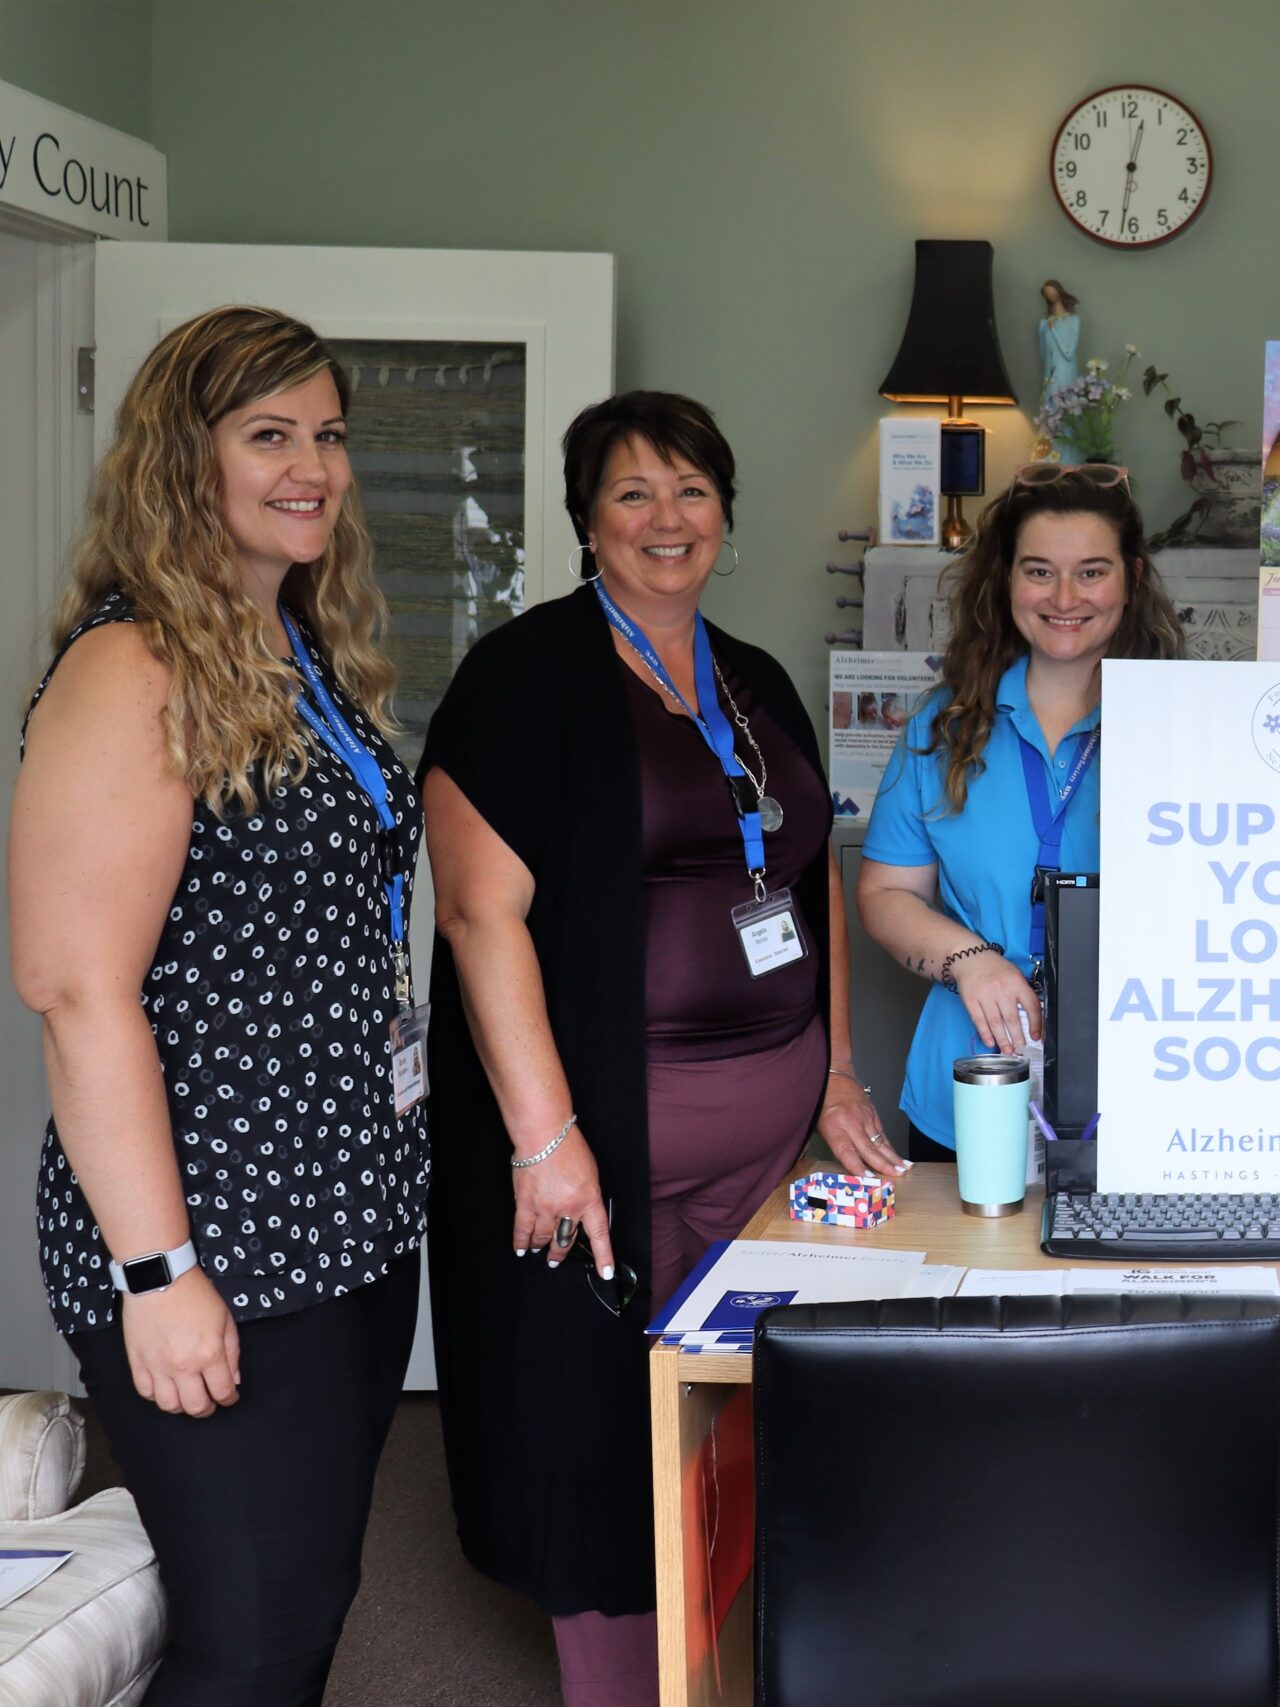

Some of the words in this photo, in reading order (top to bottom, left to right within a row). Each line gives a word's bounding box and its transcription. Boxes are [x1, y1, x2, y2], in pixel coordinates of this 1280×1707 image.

[1121, 101, 1138, 118] 12
[1157, 108, 1163, 125] 1
[1096, 110, 1107, 128] 11
[1074, 133, 1091, 150] 10
[1176, 128, 1188, 146] 2
[1065, 161, 1077, 178] 9
[1186, 157, 1198, 174] 3
[33, 132, 150, 227] Count
[1076, 190, 1087, 208] 8
[1178, 187, 1189, 204] 4
[1099, 210, 1110, 227] 7
[1128, 217, 1139, 234] 6
[1157, 209, 1168, 226] 5
[1163, 1170, 1260, 1180] HASTINGS
